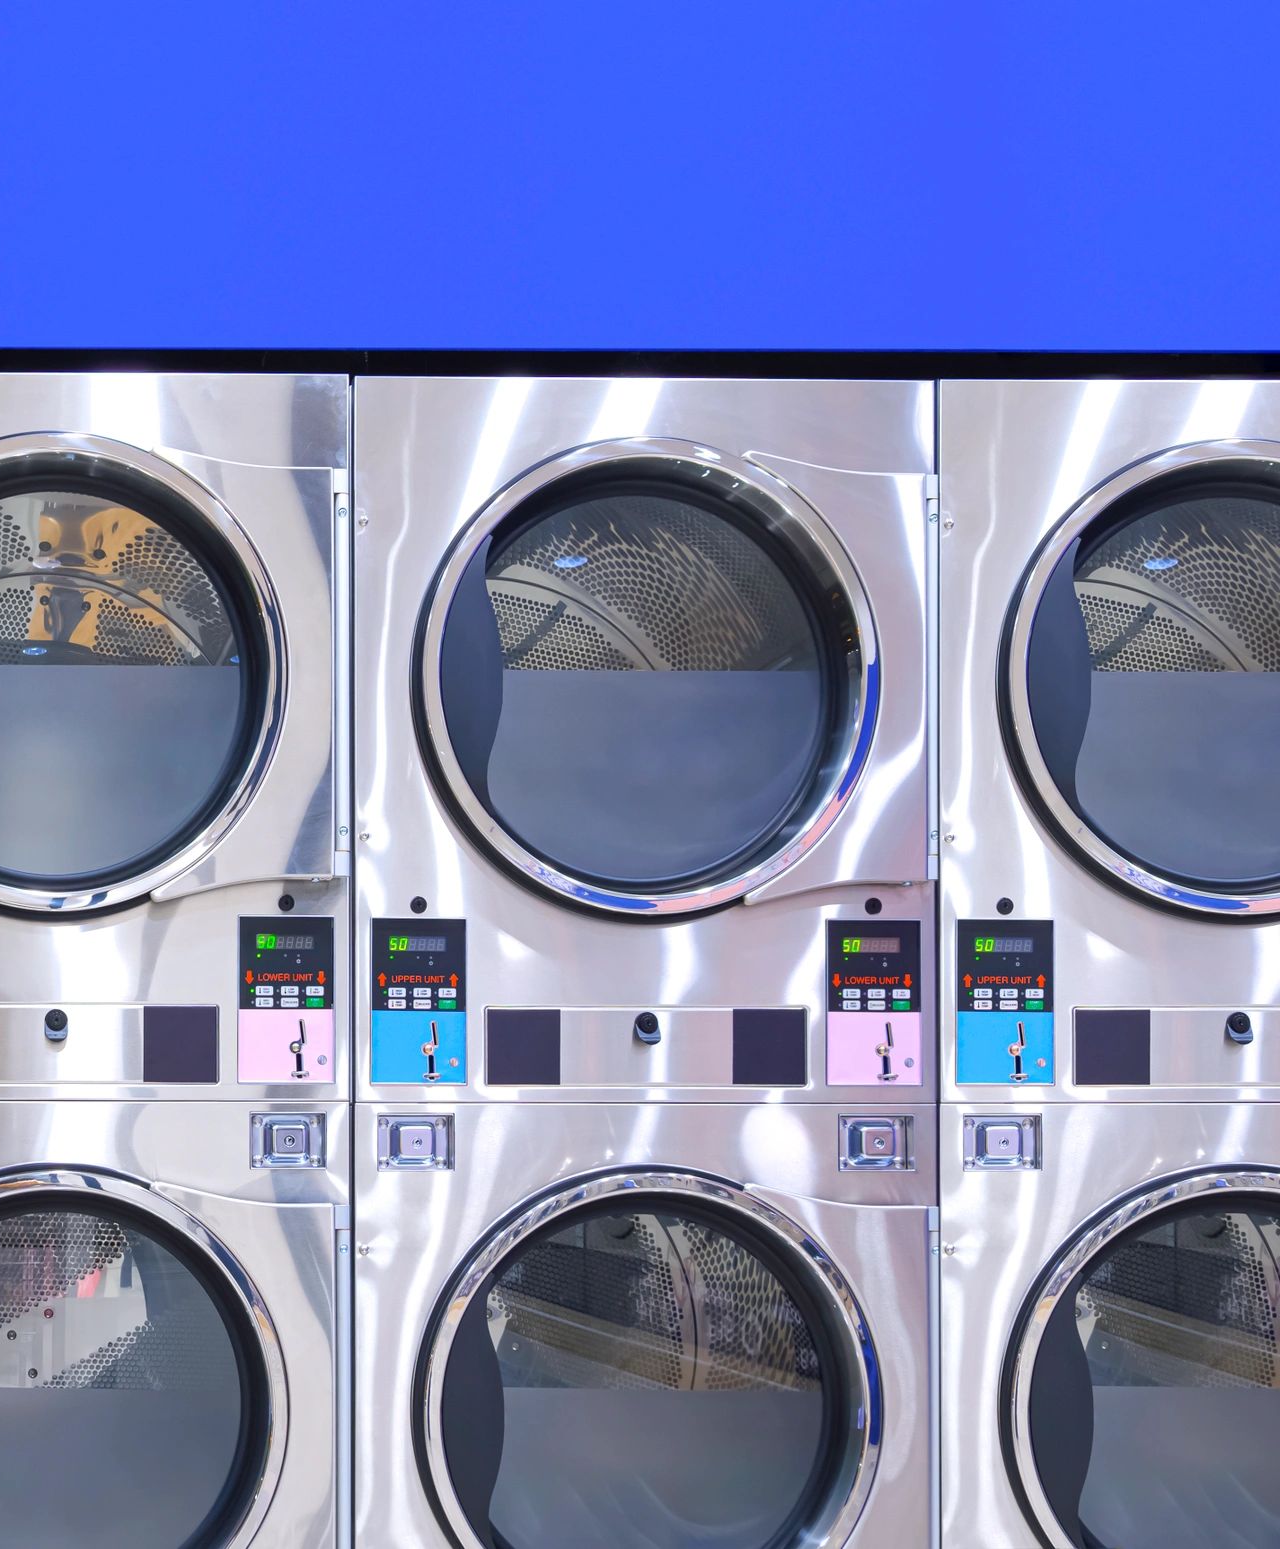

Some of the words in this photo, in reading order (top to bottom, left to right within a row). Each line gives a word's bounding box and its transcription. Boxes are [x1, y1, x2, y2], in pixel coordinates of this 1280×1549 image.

[389, 938, 408, 951] 50
[843, 939, 861, 953] 50
[975, 939, 994, 952] 50
[257, 973, 291, 981] LOWER
[292, 973, 313, 981] UNIT
[391, 975, 422, 983] UPPER
[424, 975, 445, 983] UNIT
[844, 977, 877, 985] LOWER
[879, 977, 900, 985] UNIT
[977, 976, 1009, 984] UPPER
[1010, 976, 1032, 984] UNIT
